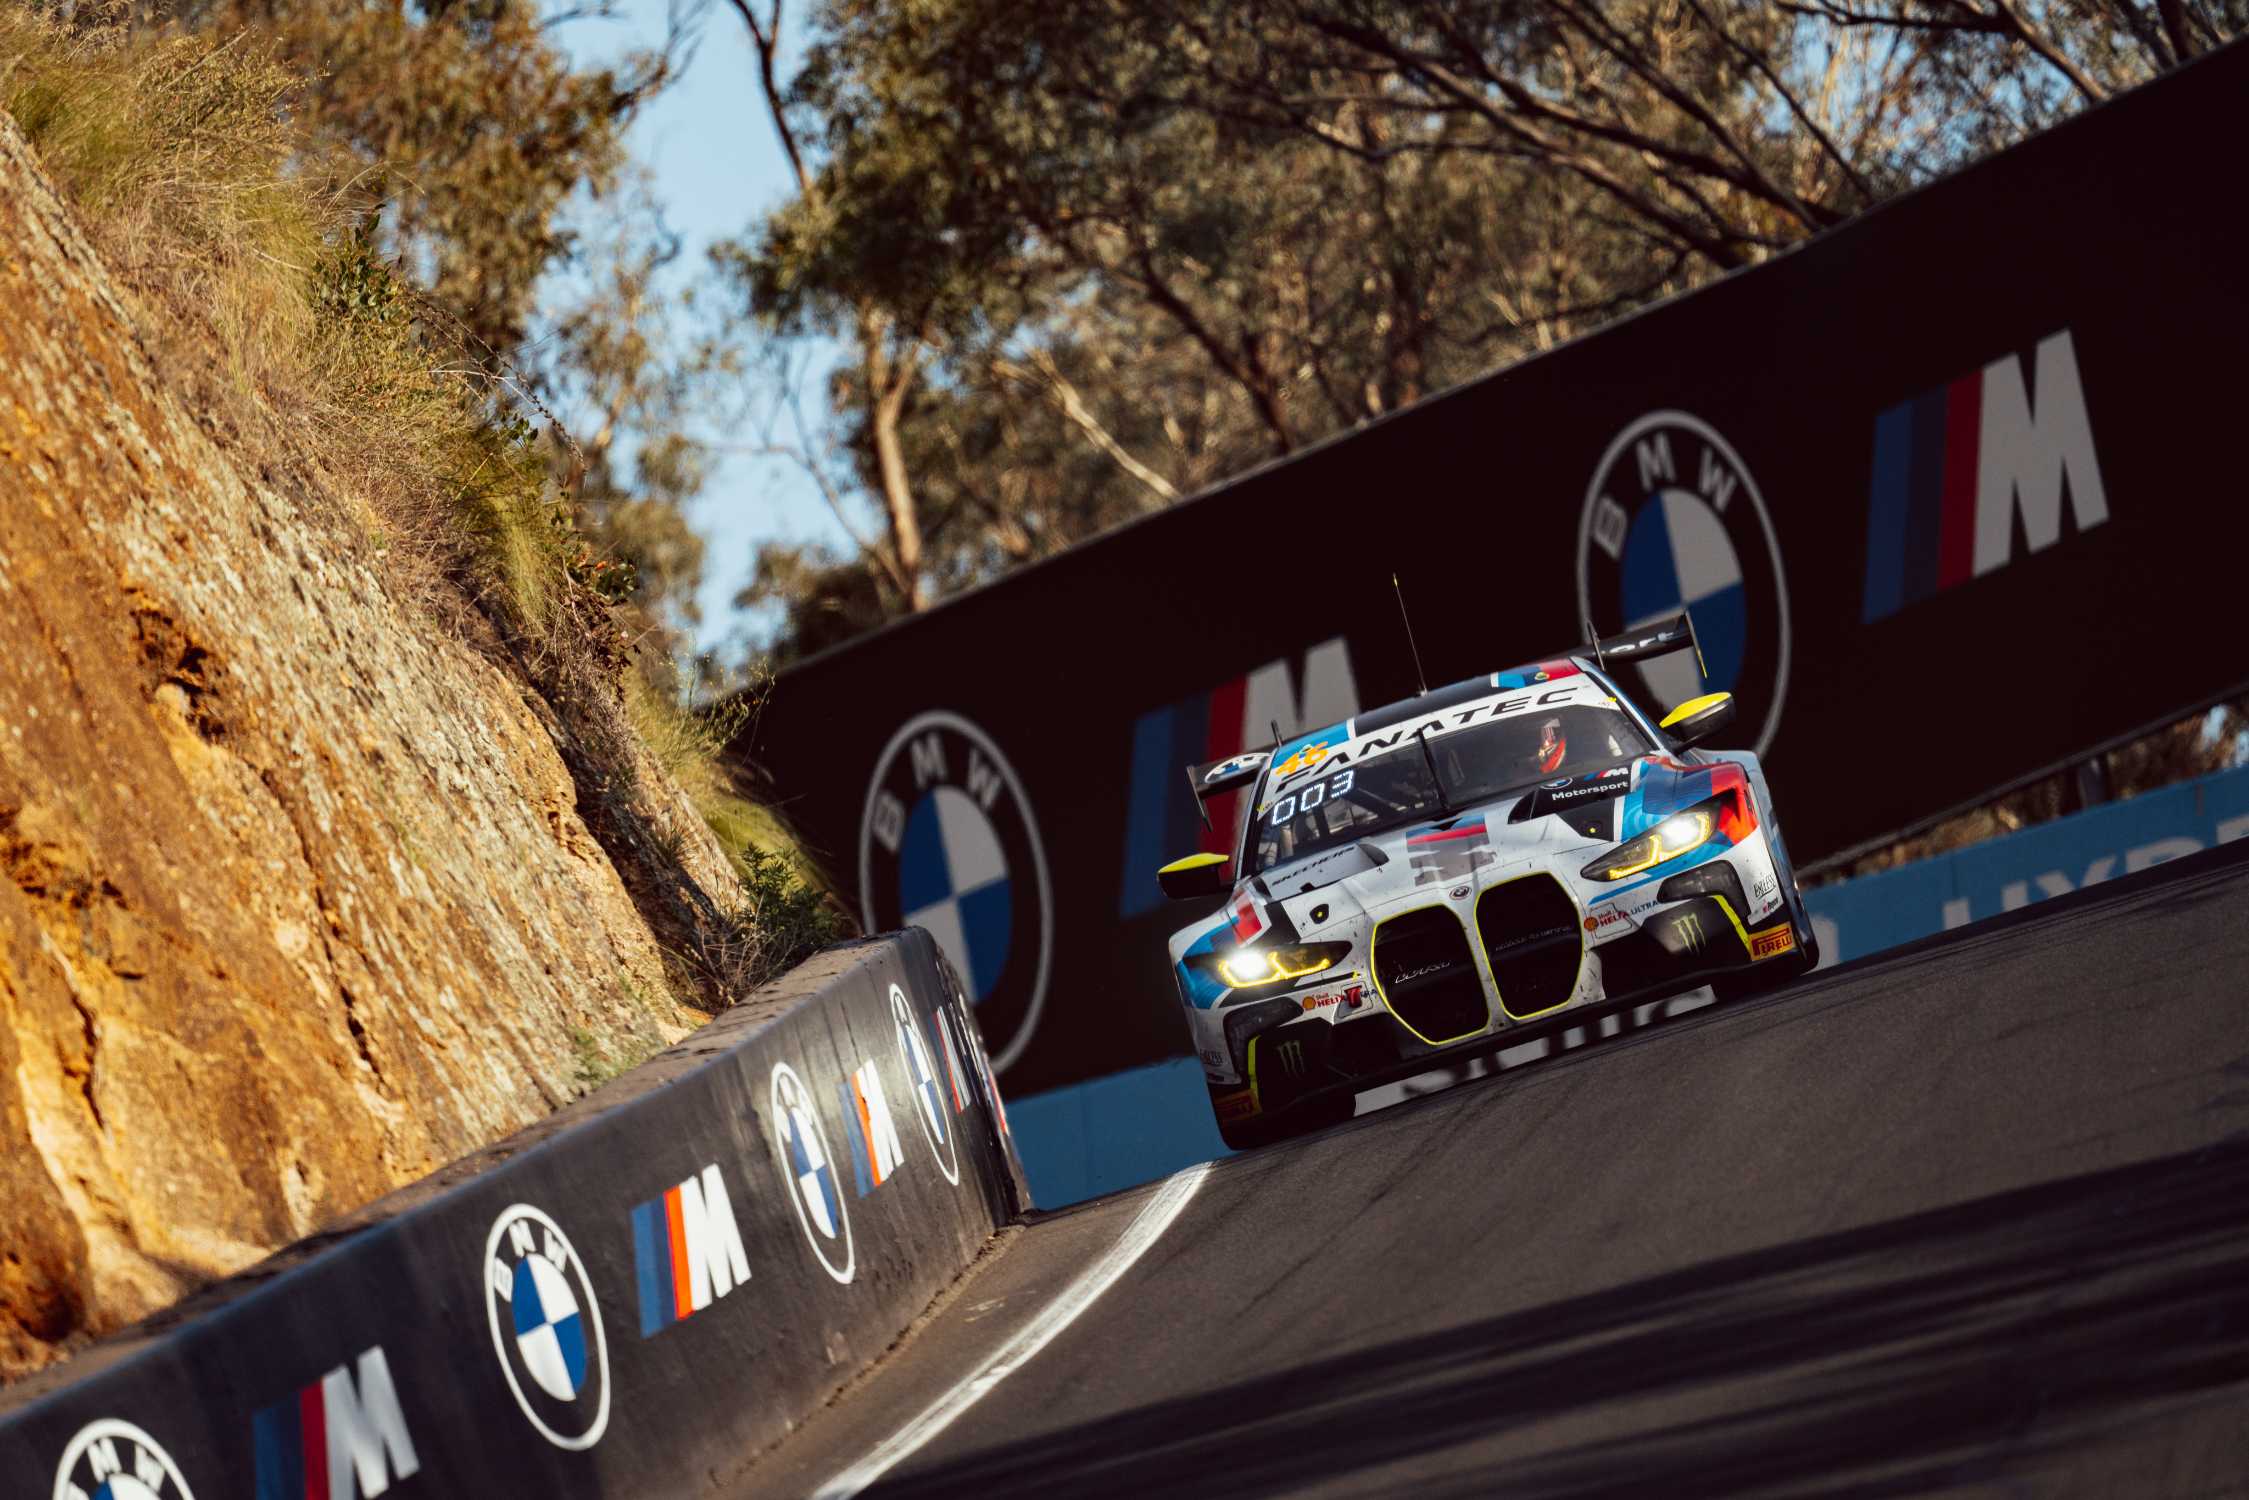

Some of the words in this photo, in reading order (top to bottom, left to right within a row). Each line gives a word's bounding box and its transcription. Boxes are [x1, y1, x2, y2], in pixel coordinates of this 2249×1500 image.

[1594, 430, 1738, 560] BMW
[1972, 327, 2110, 578] M
[872, 733, 1001, 853] BMW
[1275, 741, 1328, 776] 46
[1276, 687, 1578, 793] FANATEC
[1551, 781, 1629, 801] Motorsport
[1272, 770, 1354, 825] 003
[1630, 900, 1658, 915] ULTRA
[493, 1219, 567, 1303] BMW
[679, 1163, 752, 1311] M
[321, 1345, 420, 1500] M
